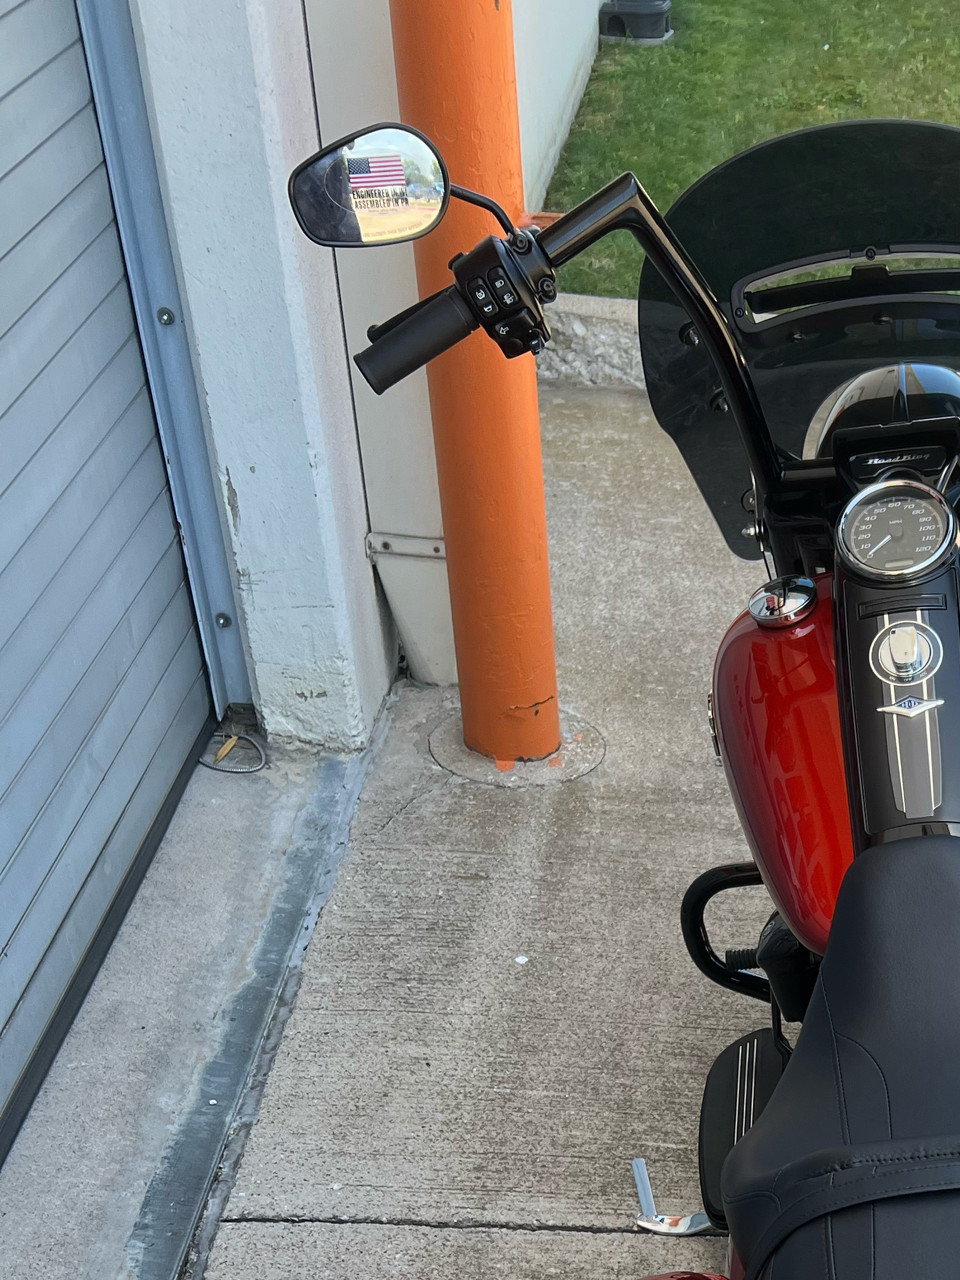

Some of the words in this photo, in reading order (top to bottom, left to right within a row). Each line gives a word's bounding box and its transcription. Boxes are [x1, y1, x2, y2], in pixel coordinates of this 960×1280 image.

[354, 199, 391, 209] ASSEMBLED
[919, 524, 936, 532] 100
[915, 545, 932, 553] 120
